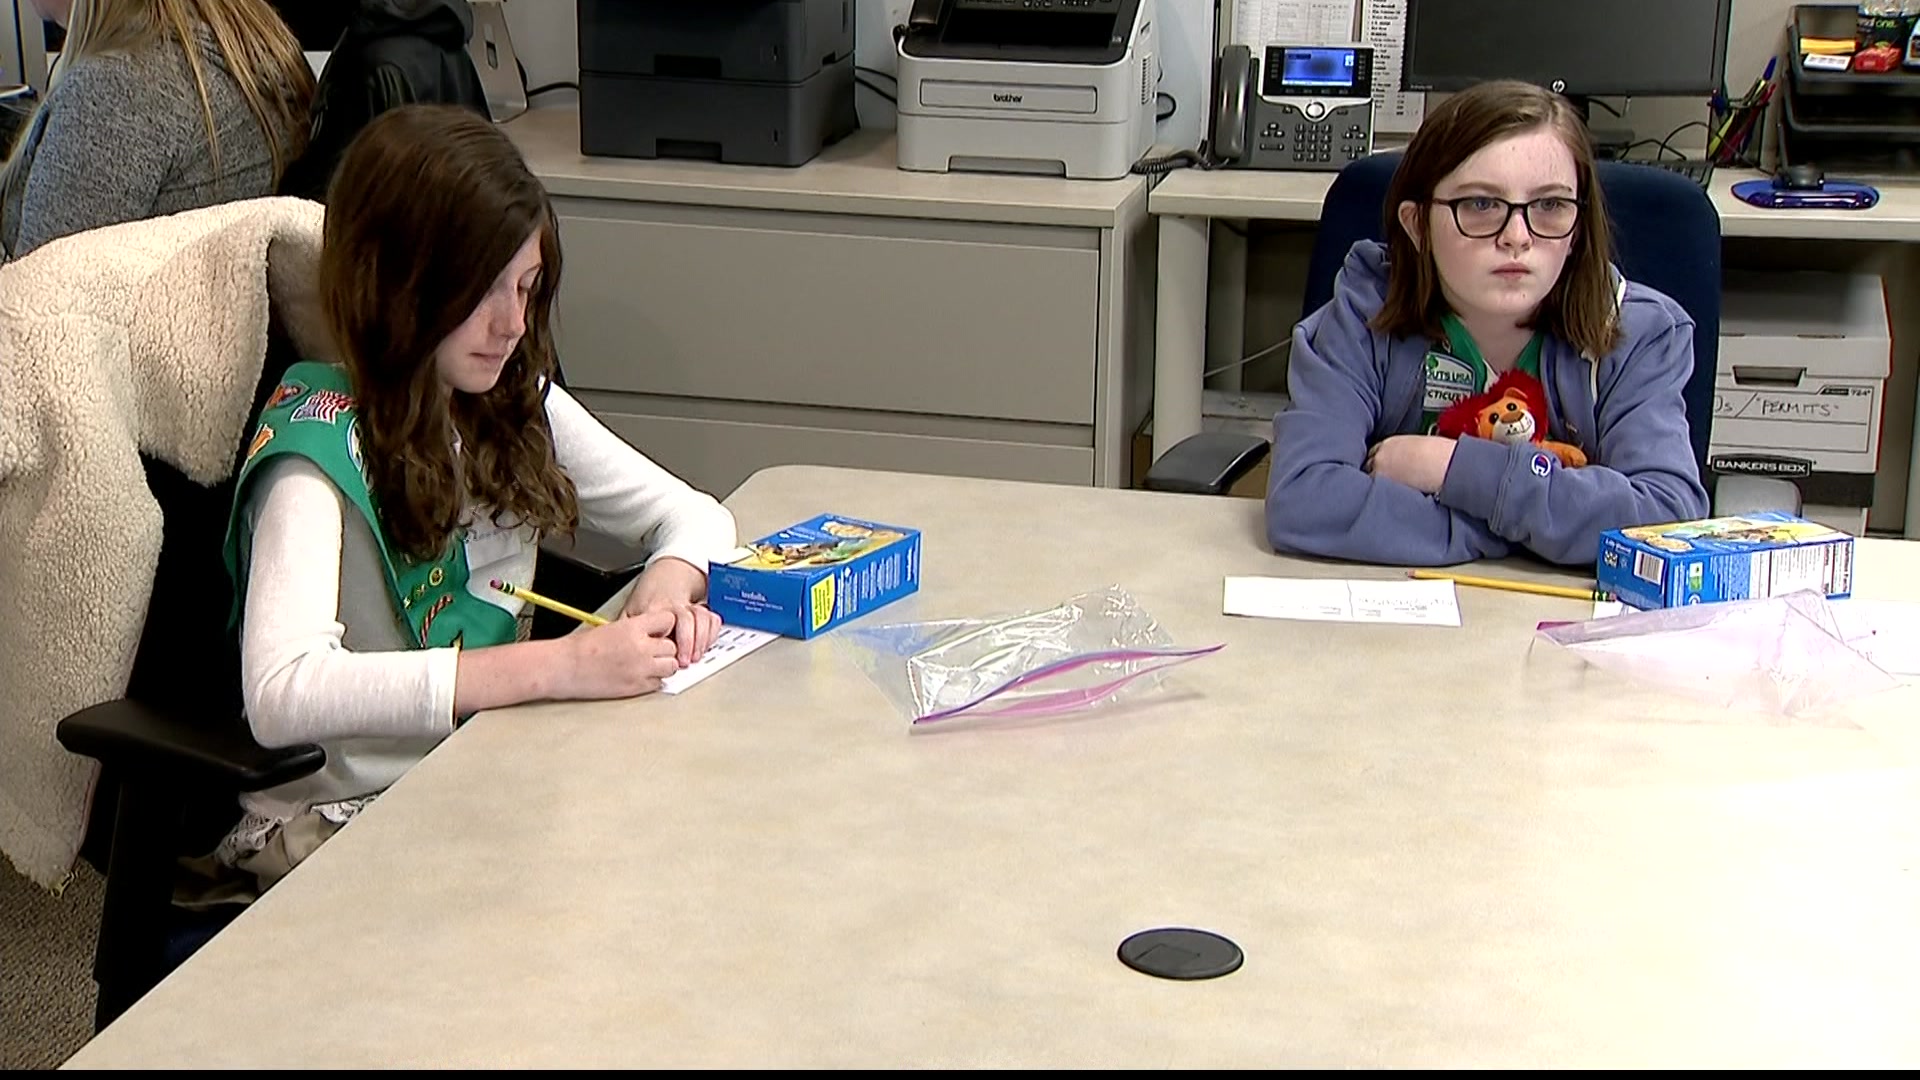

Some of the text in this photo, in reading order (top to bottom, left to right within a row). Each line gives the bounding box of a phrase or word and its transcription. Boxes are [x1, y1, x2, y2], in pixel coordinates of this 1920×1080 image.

[993, 93, 1023, 103] brother
[1716, 459, 1807, 473] BANKERS BOX
